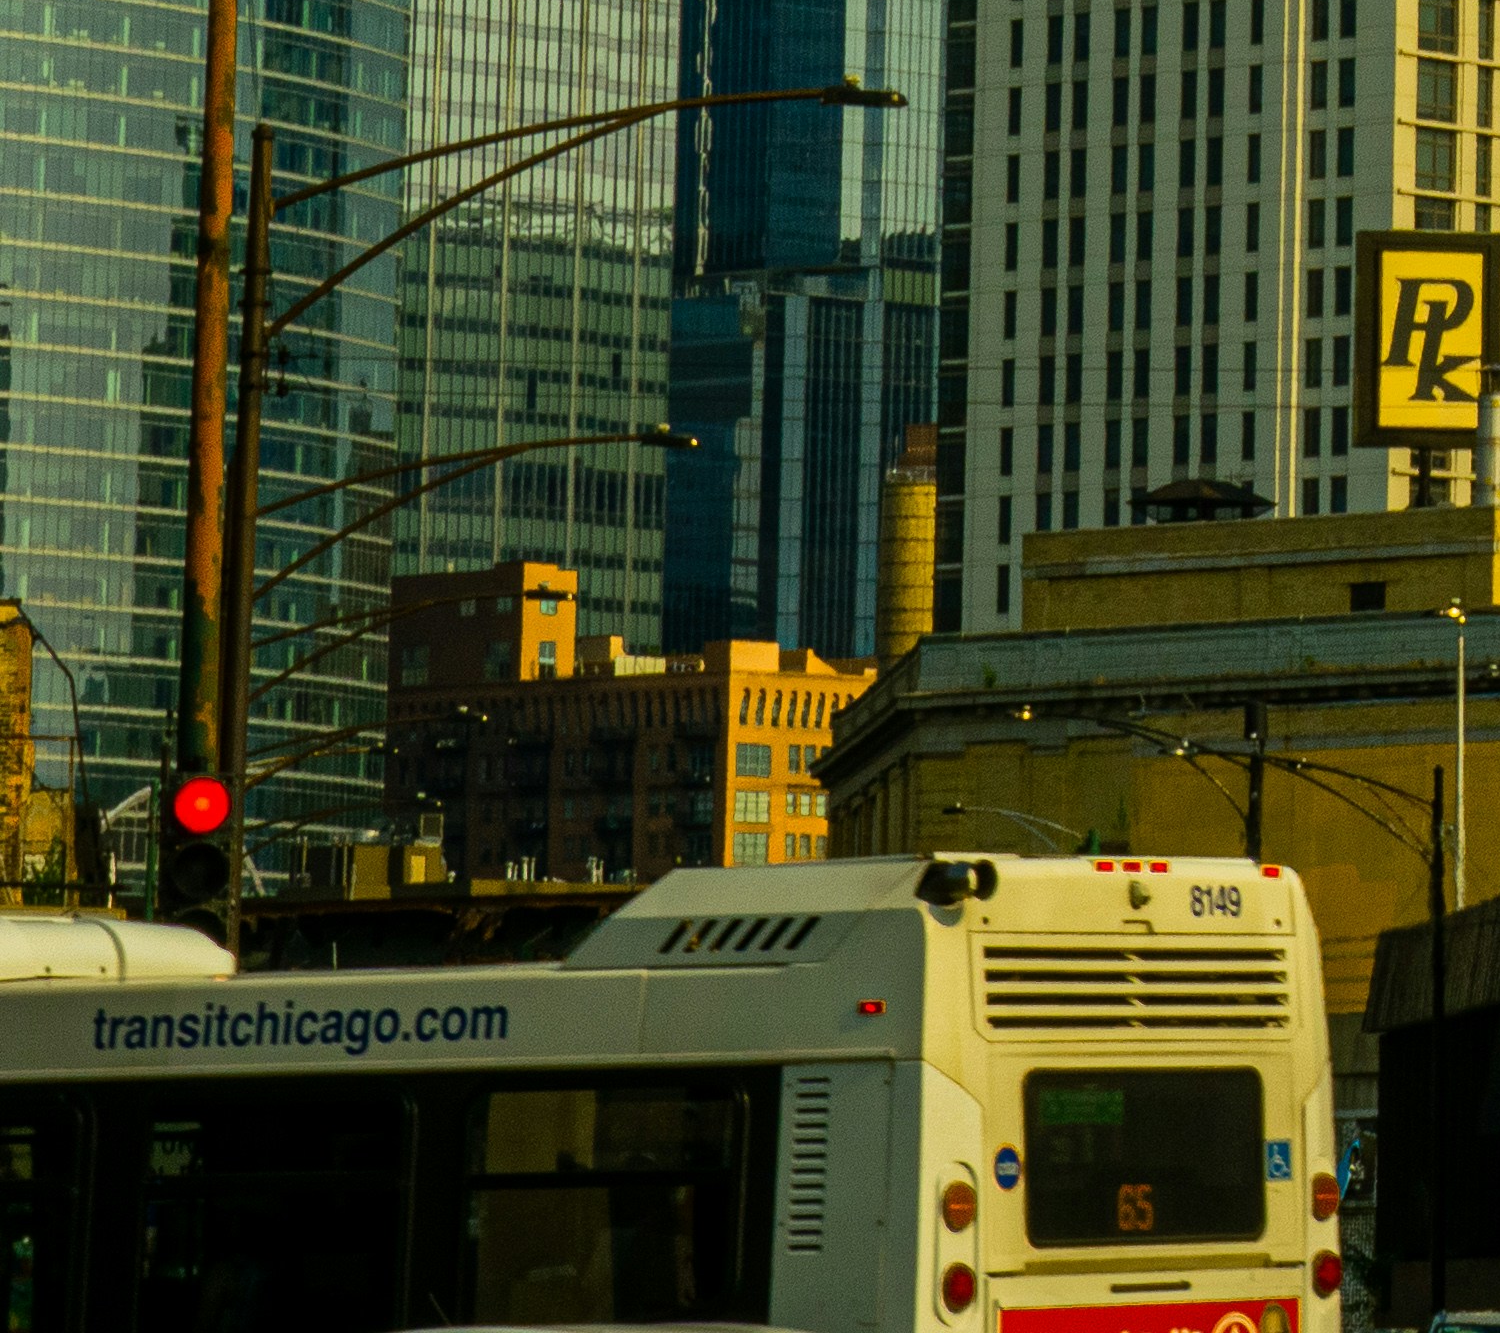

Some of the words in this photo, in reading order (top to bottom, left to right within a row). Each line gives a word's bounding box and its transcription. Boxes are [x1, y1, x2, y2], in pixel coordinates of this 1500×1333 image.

[1189, 885, 1242, 919] 8149
[92, 1000, 510, 1057] transitchicago.com
[1116, 1183, 1155, 1232] 65
